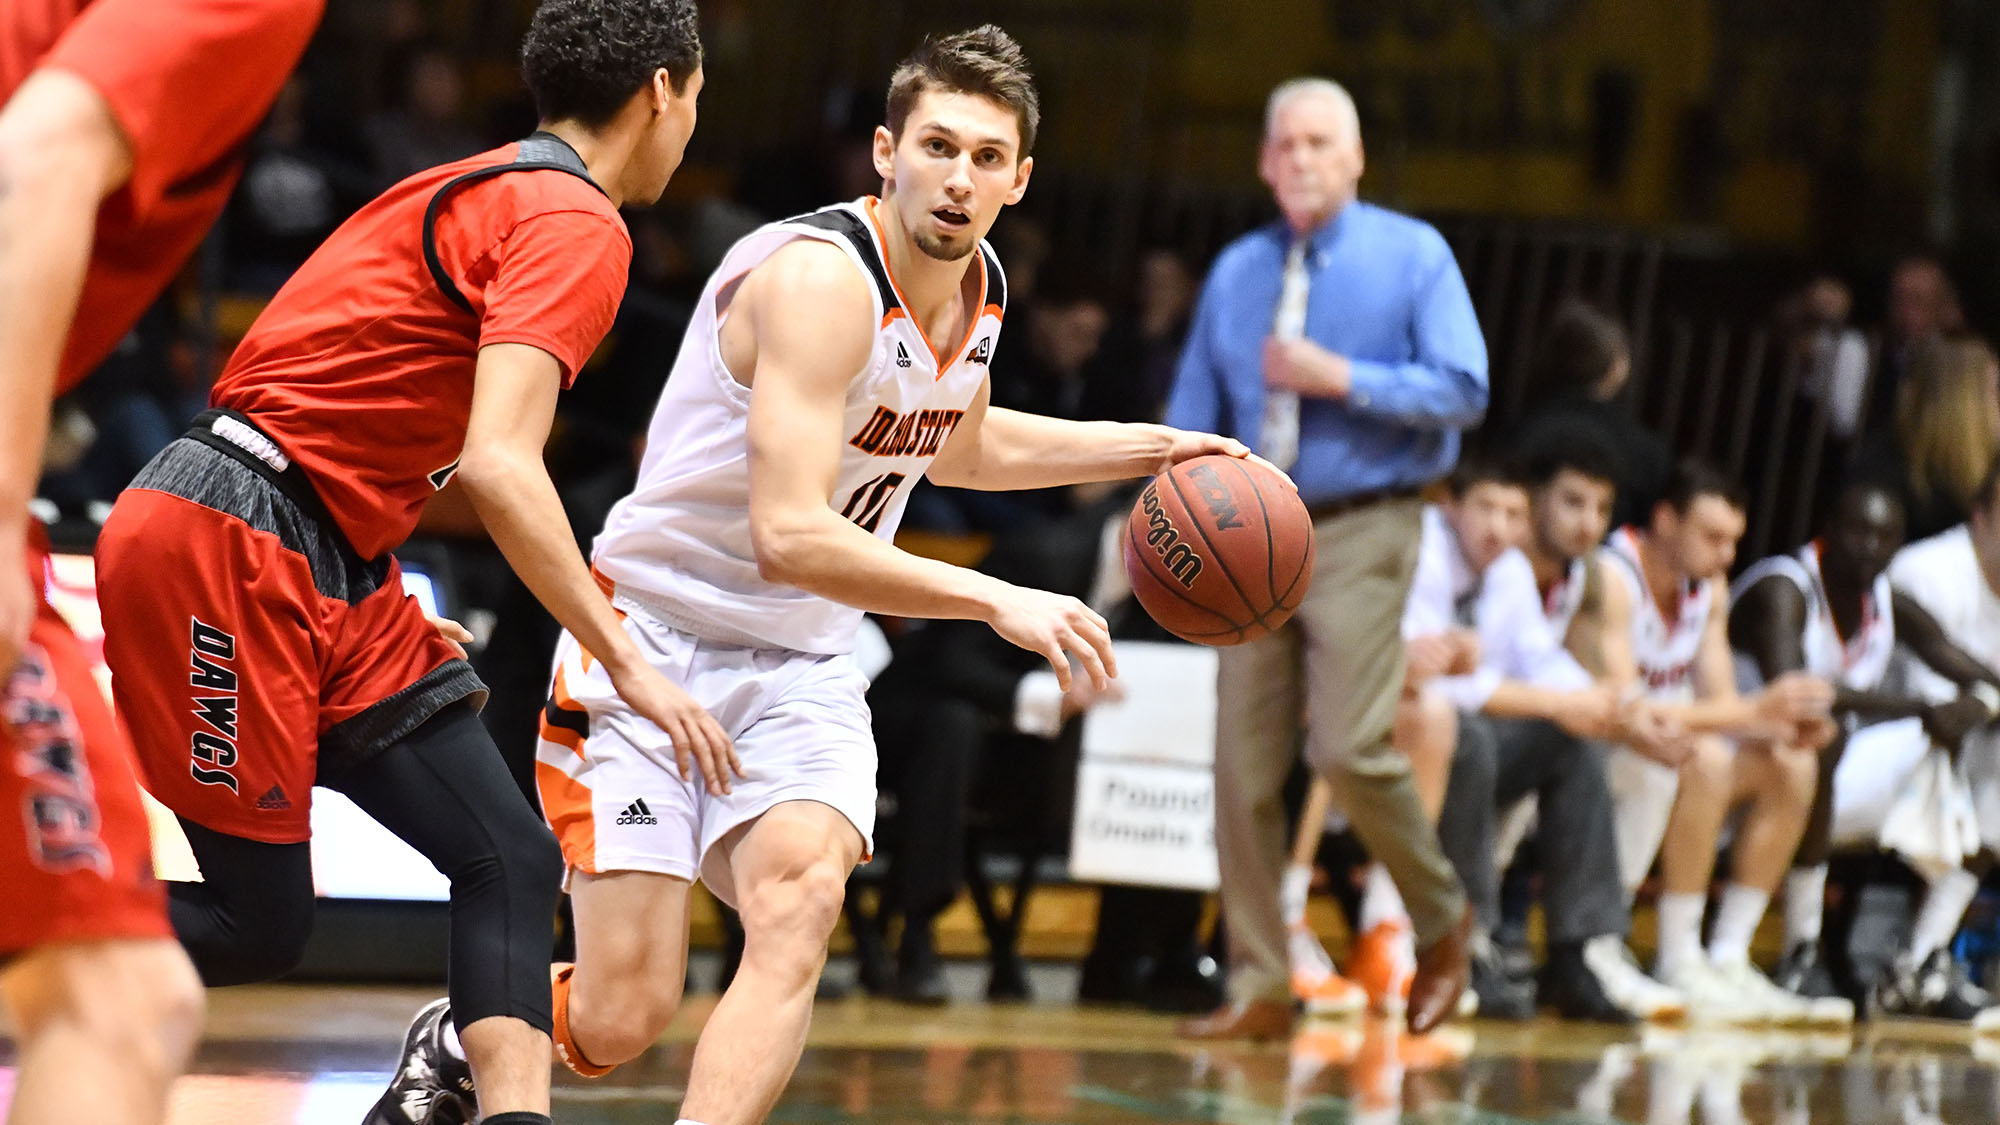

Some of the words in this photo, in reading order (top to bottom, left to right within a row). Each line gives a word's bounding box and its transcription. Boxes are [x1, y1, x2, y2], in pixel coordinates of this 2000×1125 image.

[1142, 480, 1204, 591] Wilson
[1187, 463, 1243, 532] NCAA
[190, 614, 239, 797] DAWGS
[616, 814, 658, 825] adidas
